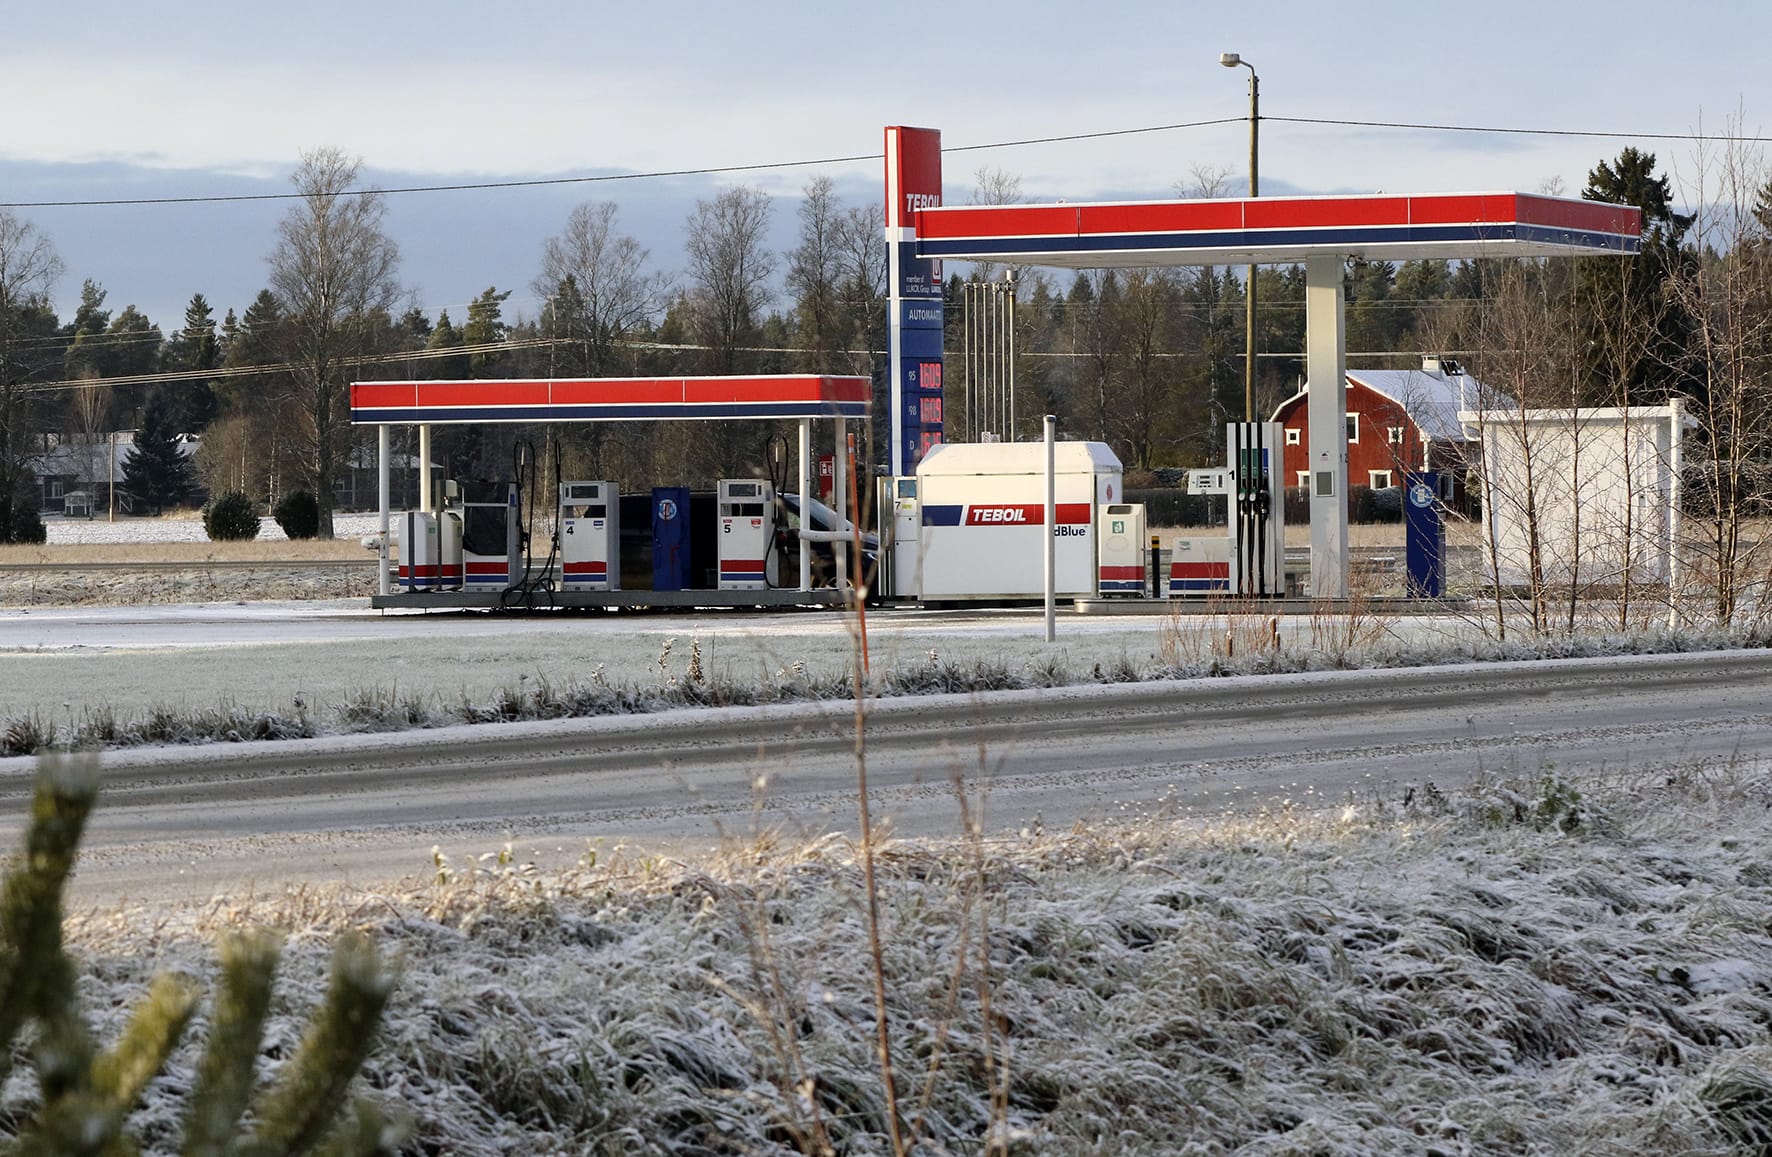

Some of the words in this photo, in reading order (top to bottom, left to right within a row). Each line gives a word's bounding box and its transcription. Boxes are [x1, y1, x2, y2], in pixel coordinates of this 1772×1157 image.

[906, 193, 940, 212] TEBOIL
[908, 370, 916, 381] 95
[908, 405, 917, 416] 98
[909, 440, 915, 450] D
[1229, 470, 1235, 480] 1
[895, 501, 901, 510] 7
[973, 508, 1026, 522] TEBOIL
[566, 526, 574, 535] 4
[724, 524, 731, 533] 5
[1053, 525, 1086, 537] dBlue
